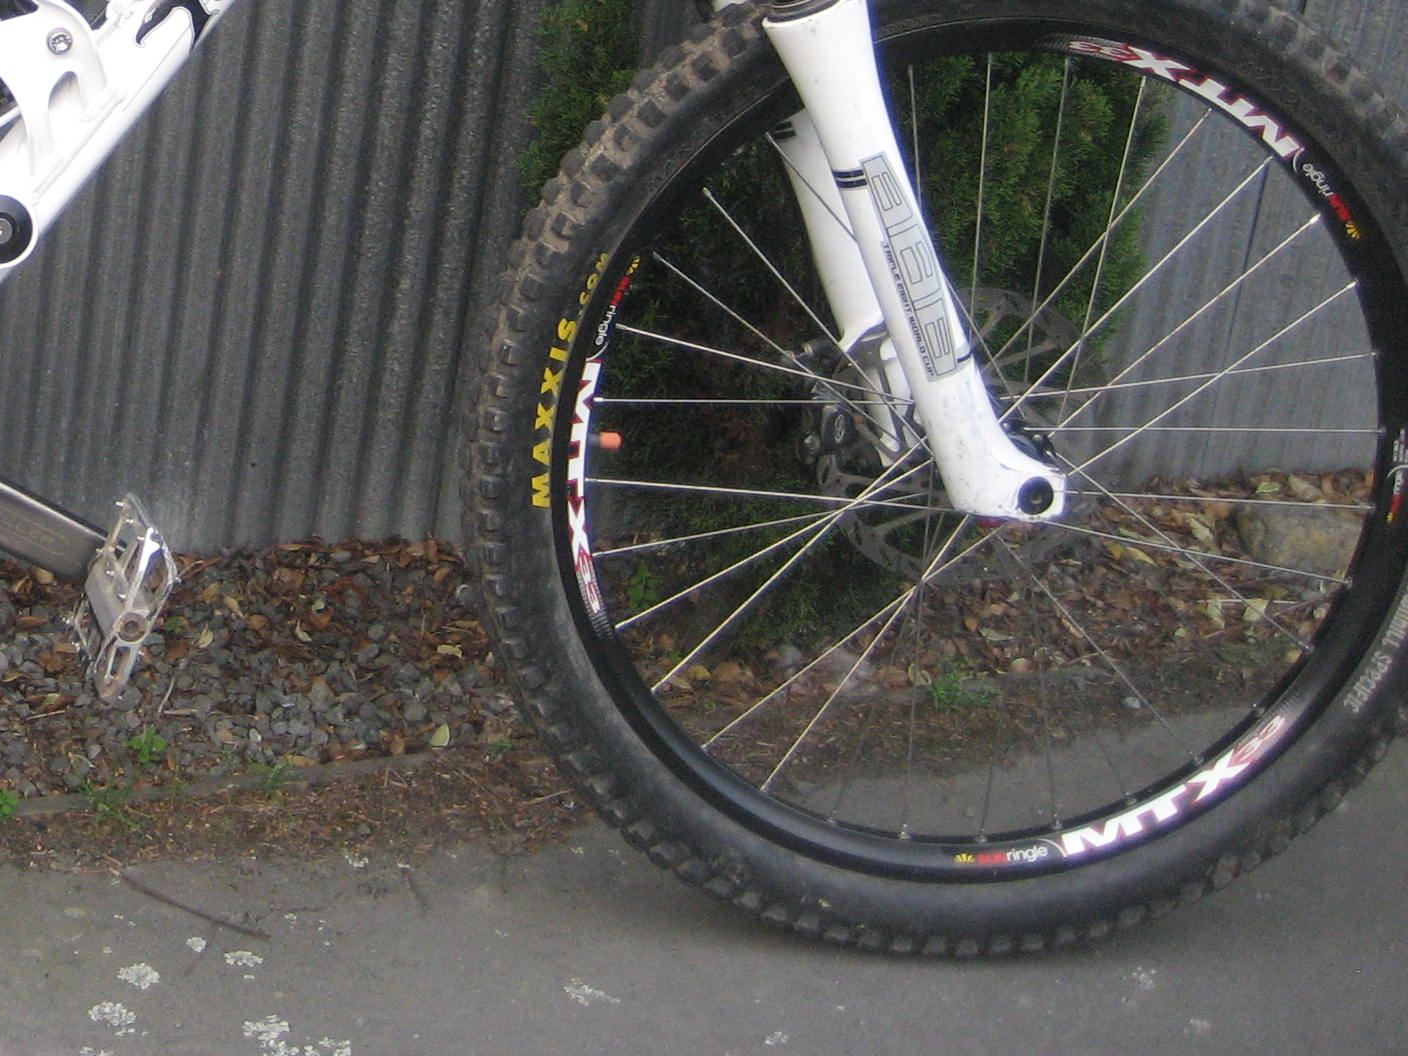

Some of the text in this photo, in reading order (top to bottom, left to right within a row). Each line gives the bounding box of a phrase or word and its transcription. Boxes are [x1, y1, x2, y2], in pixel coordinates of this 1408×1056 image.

[882, 243, 901, 282] TRIPLE
[894, 282, 913, 314] EIGHT
[907, 315, 927, 354] WORLD
